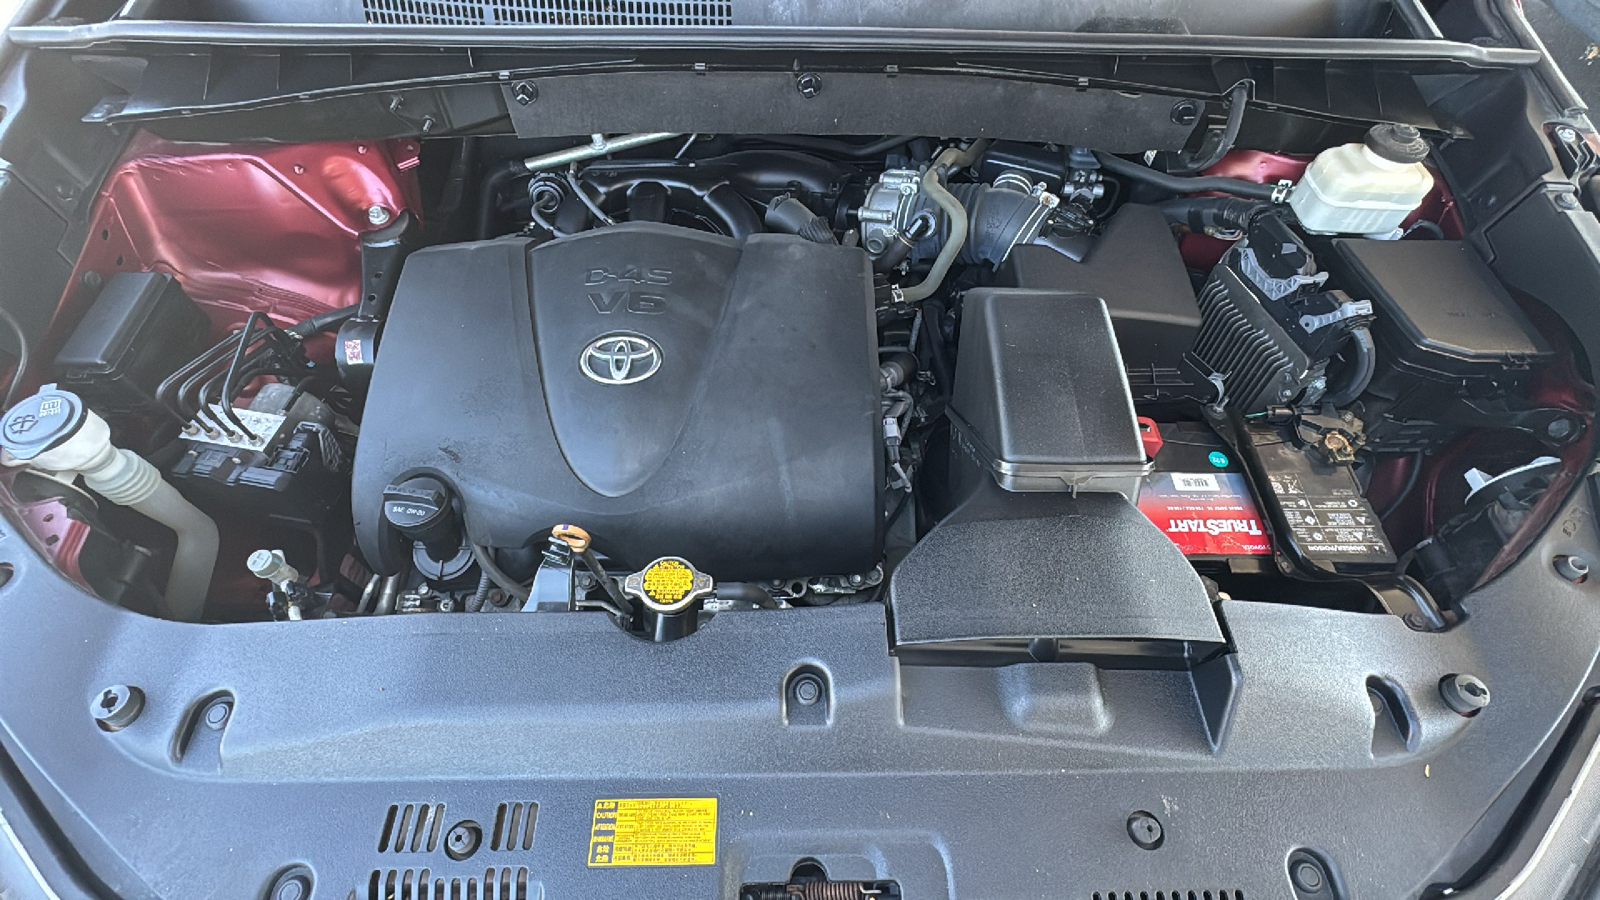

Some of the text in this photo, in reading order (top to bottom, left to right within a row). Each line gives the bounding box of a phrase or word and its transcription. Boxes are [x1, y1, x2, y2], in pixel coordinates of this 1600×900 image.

[584, 267, 673, 286] D-4S
[587, 291, 667, 315] V6
[1307, 544, 1367, 552] DANGER/POISON
